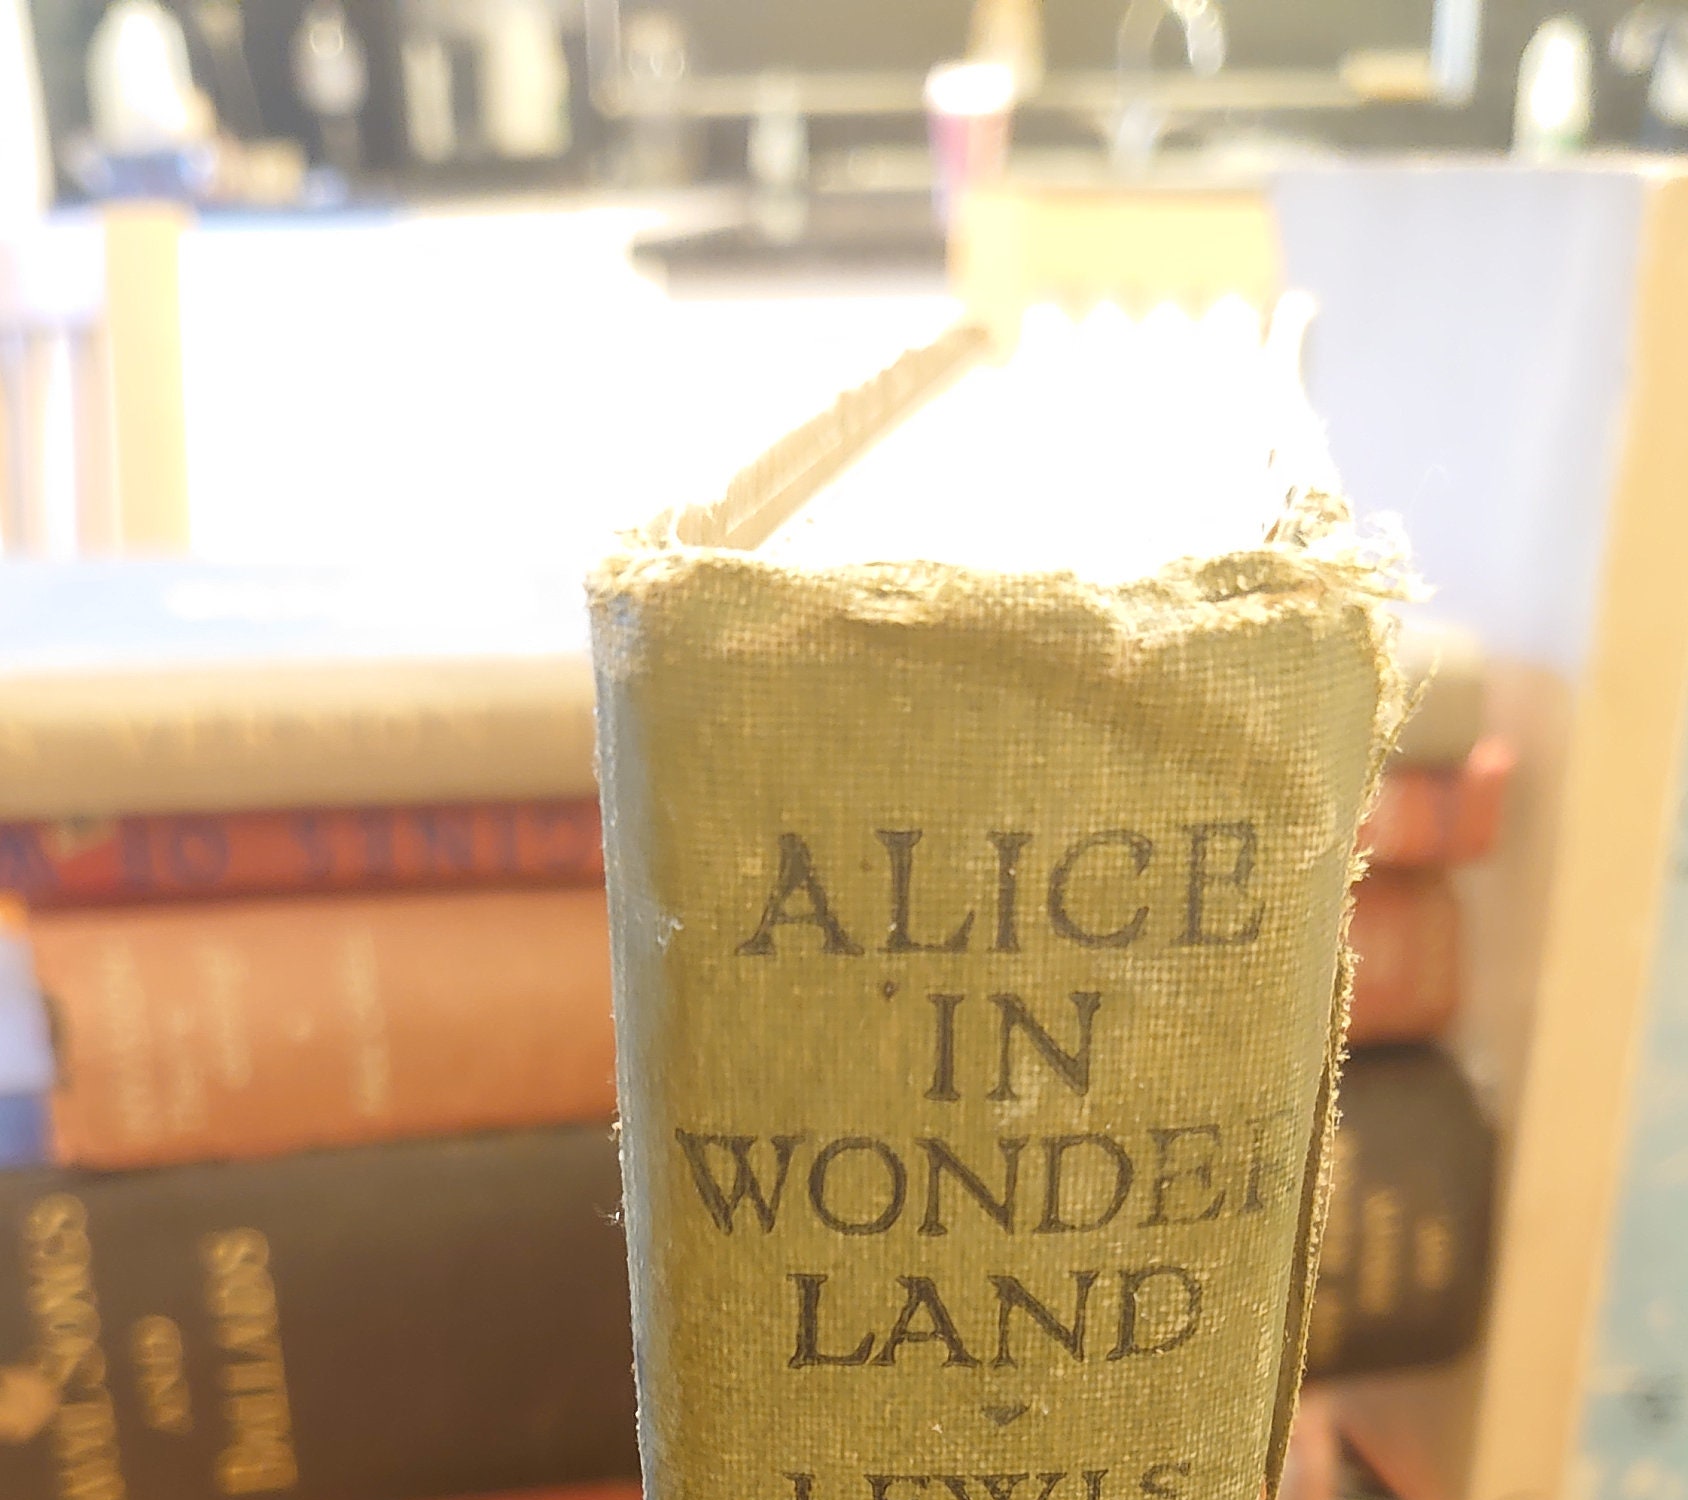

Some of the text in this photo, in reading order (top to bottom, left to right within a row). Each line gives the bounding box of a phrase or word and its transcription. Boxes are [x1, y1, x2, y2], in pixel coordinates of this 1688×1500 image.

[734, 822, 1268, 957] ALICE
[924, 990, 1103, 1102] IN
[130, 1313, 194, 1436] AND
[202, 1226, 298, 1495] BALLADS
[787, 1265, 1205, 1370] LAND
